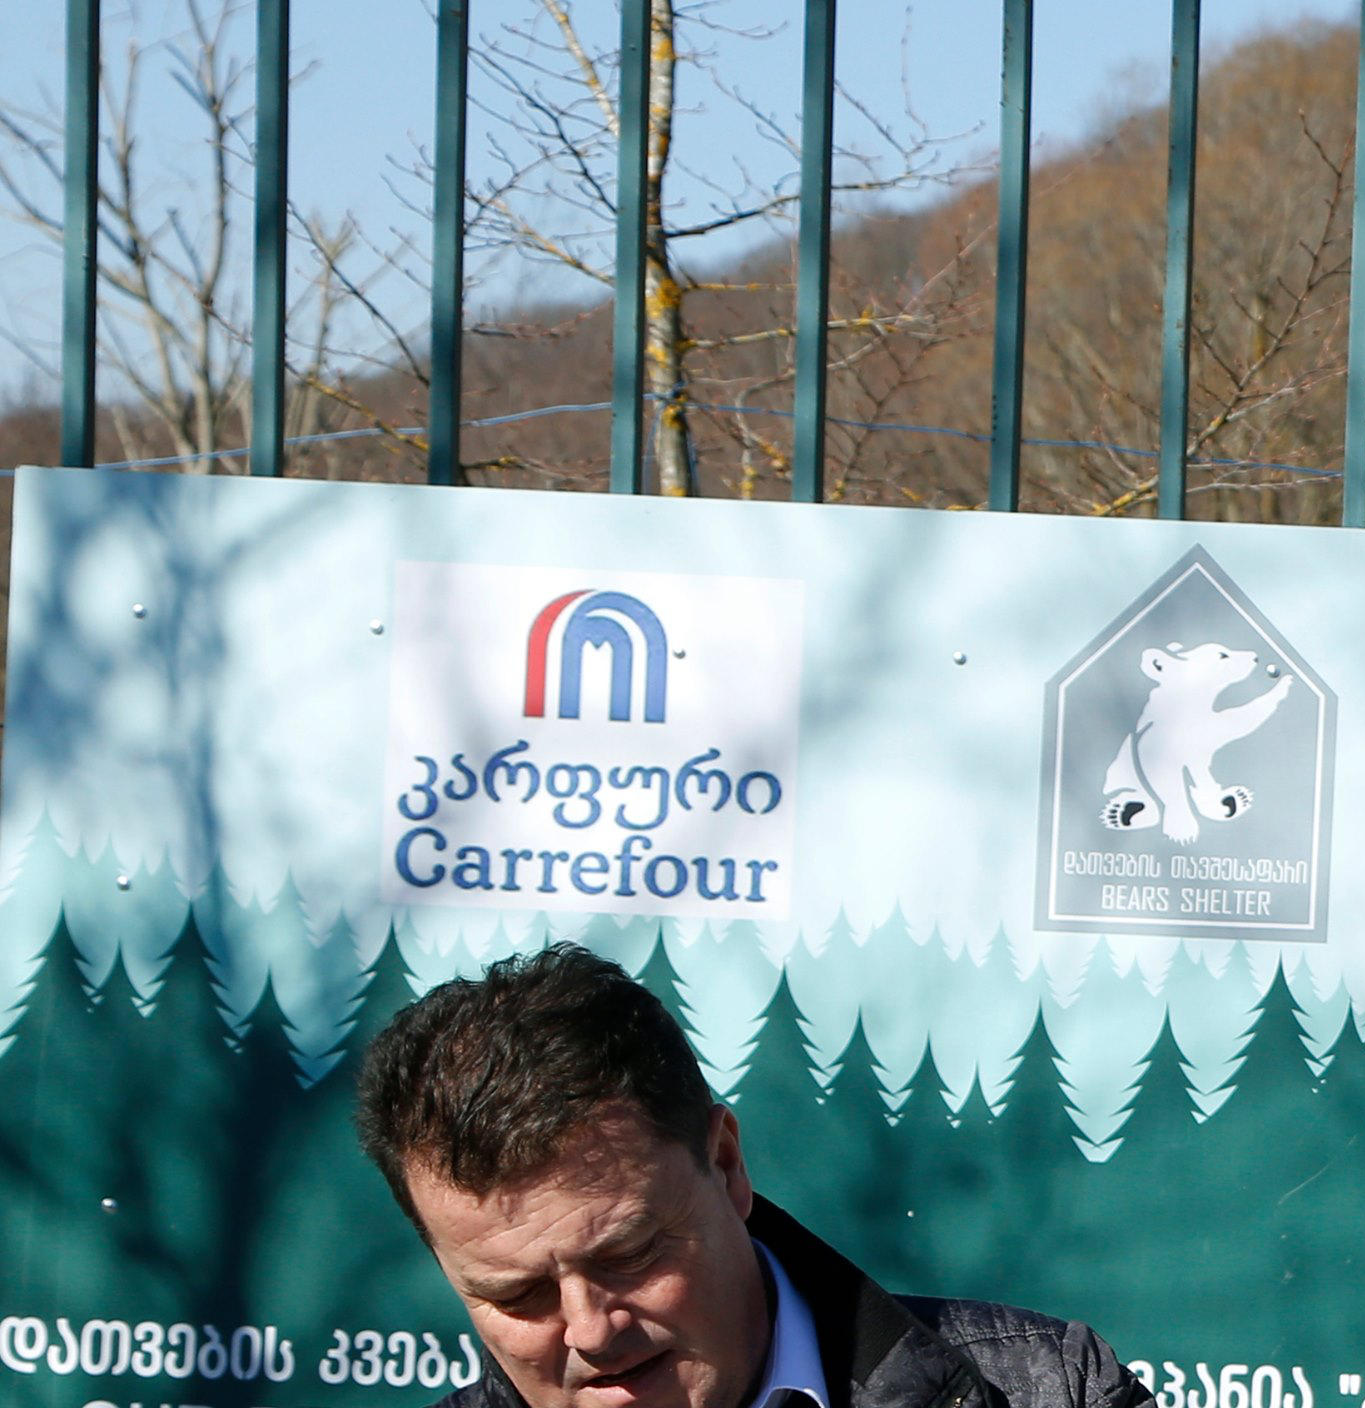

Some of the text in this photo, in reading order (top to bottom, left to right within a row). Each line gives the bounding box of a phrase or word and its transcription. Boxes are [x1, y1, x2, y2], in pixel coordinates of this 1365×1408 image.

[397, 739, 784, 831] კარფური
[393, 825, 779, 904] Carrefour
[1100, 884, 1272, 916] BEARS SHELTER
[1, 1315, 295, 1382] დათვების
